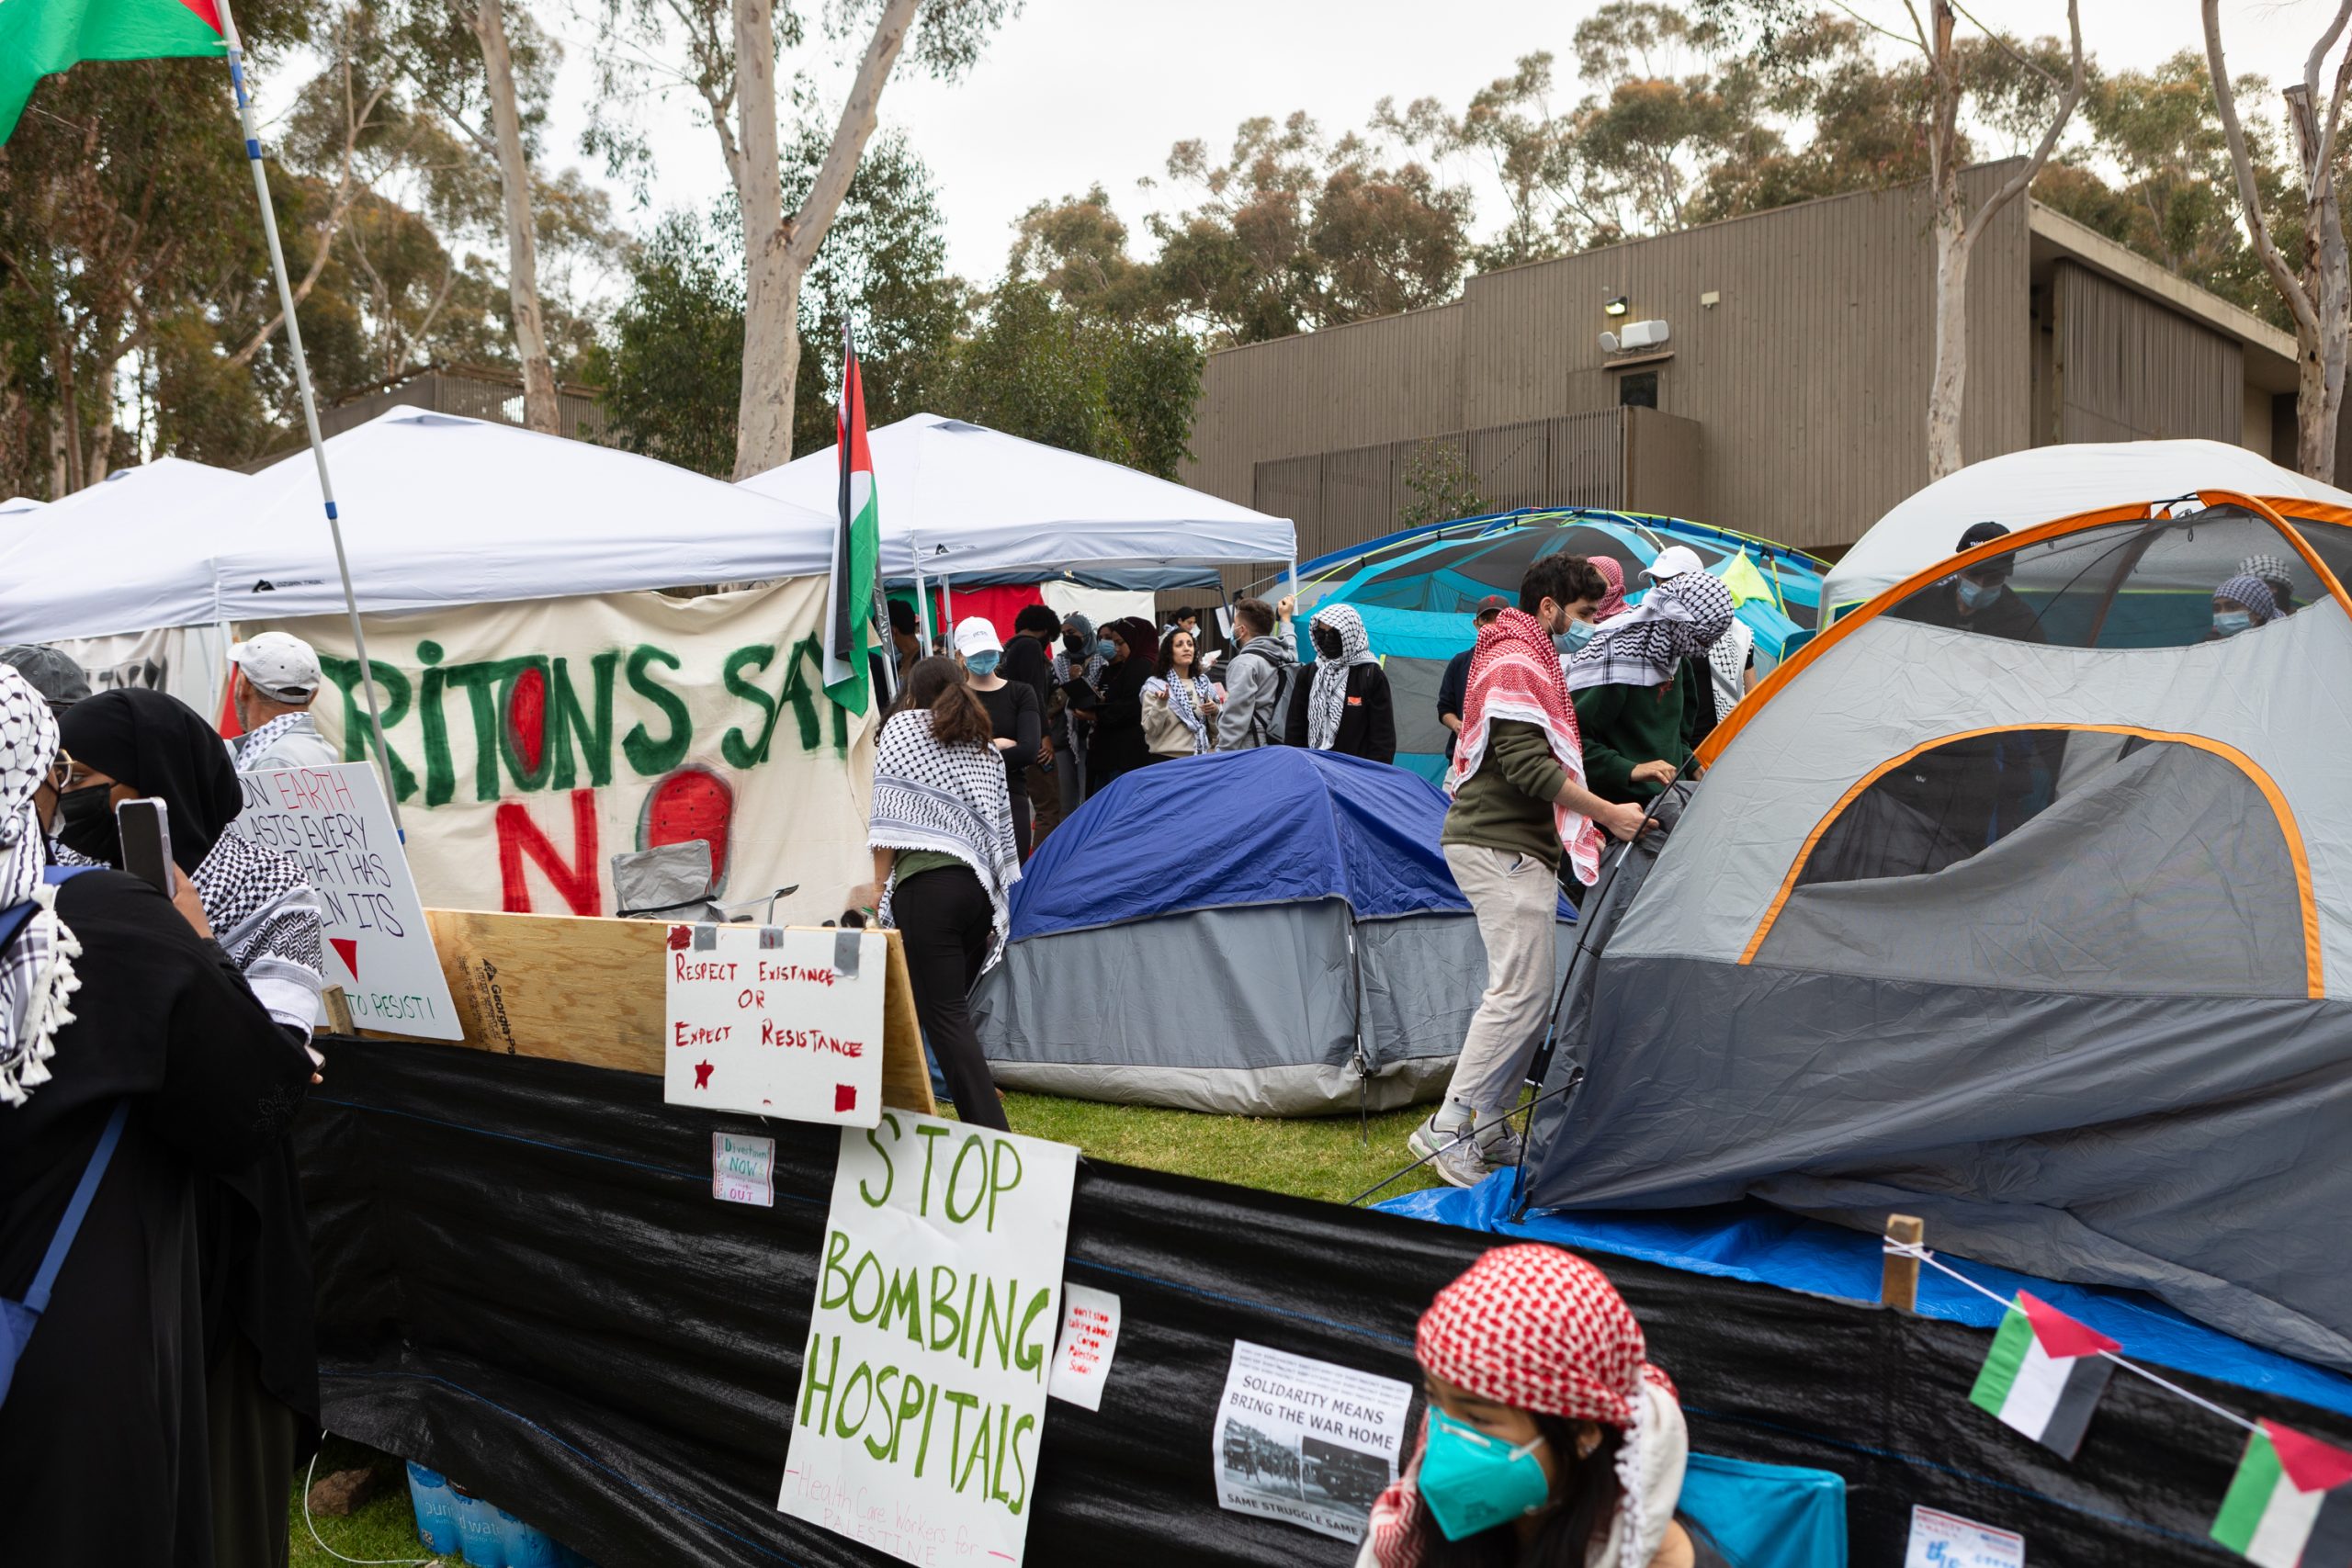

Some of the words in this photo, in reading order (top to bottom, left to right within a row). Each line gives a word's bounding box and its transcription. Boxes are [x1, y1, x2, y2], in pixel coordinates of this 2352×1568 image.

[318, 640, 693, 807] RITONS
[274, 769, 356, 814] EARTH
[301, 813, 368, 851] EVERY
[345, 853, 391, 888] HAS
[347, 893, 404, 938] ITS
[345, 993, 368, 1016] TO
[738, 989, 764, 1009] OR
[729, 1156, 757, 1176] NOW
[860, 1113, 1022, 1233] STOP
[729, 1188, 753, 1201] OUT
[820, 1231, 1050, 1384] BOMBING
[1093, 1312, 1109, 1324] stop
[1069, 1318, 1091, 1336] talking
[1091, 1325, 1113, 1338] about
[1077, 1332, 1100, 1350] Congo
[1069, 1344, 1100, 1363] Palestine
[1069, 1359, 1091, 1375] Sudan
[1242, 1375, 1329, 1409] SOLIDARITY
[1331, 1399, 1385, 1425] MEANS
[799, 1333, 1035, 1516] HOSPITALS
[1229, 1392, 1273, 1416] BRING
[1278, 1404, 1305, 1425] THE
[1309, 1414, 1343, 1437] WAR
[1349, 1427, 1395, 1450] HOME
[797, 1461, 852, 1514] Health
[896, 1499, 946, 1544] Workers
[956, 1524, 979, 1556] for
[1227, 1494, 1259, 1509] SAME
[1261, 1501, 1323, 1525] STRUGGLE
[1325, 1519, 1359, 1536] SAME
[823, 1508, 937, 1567] PALESTINE
